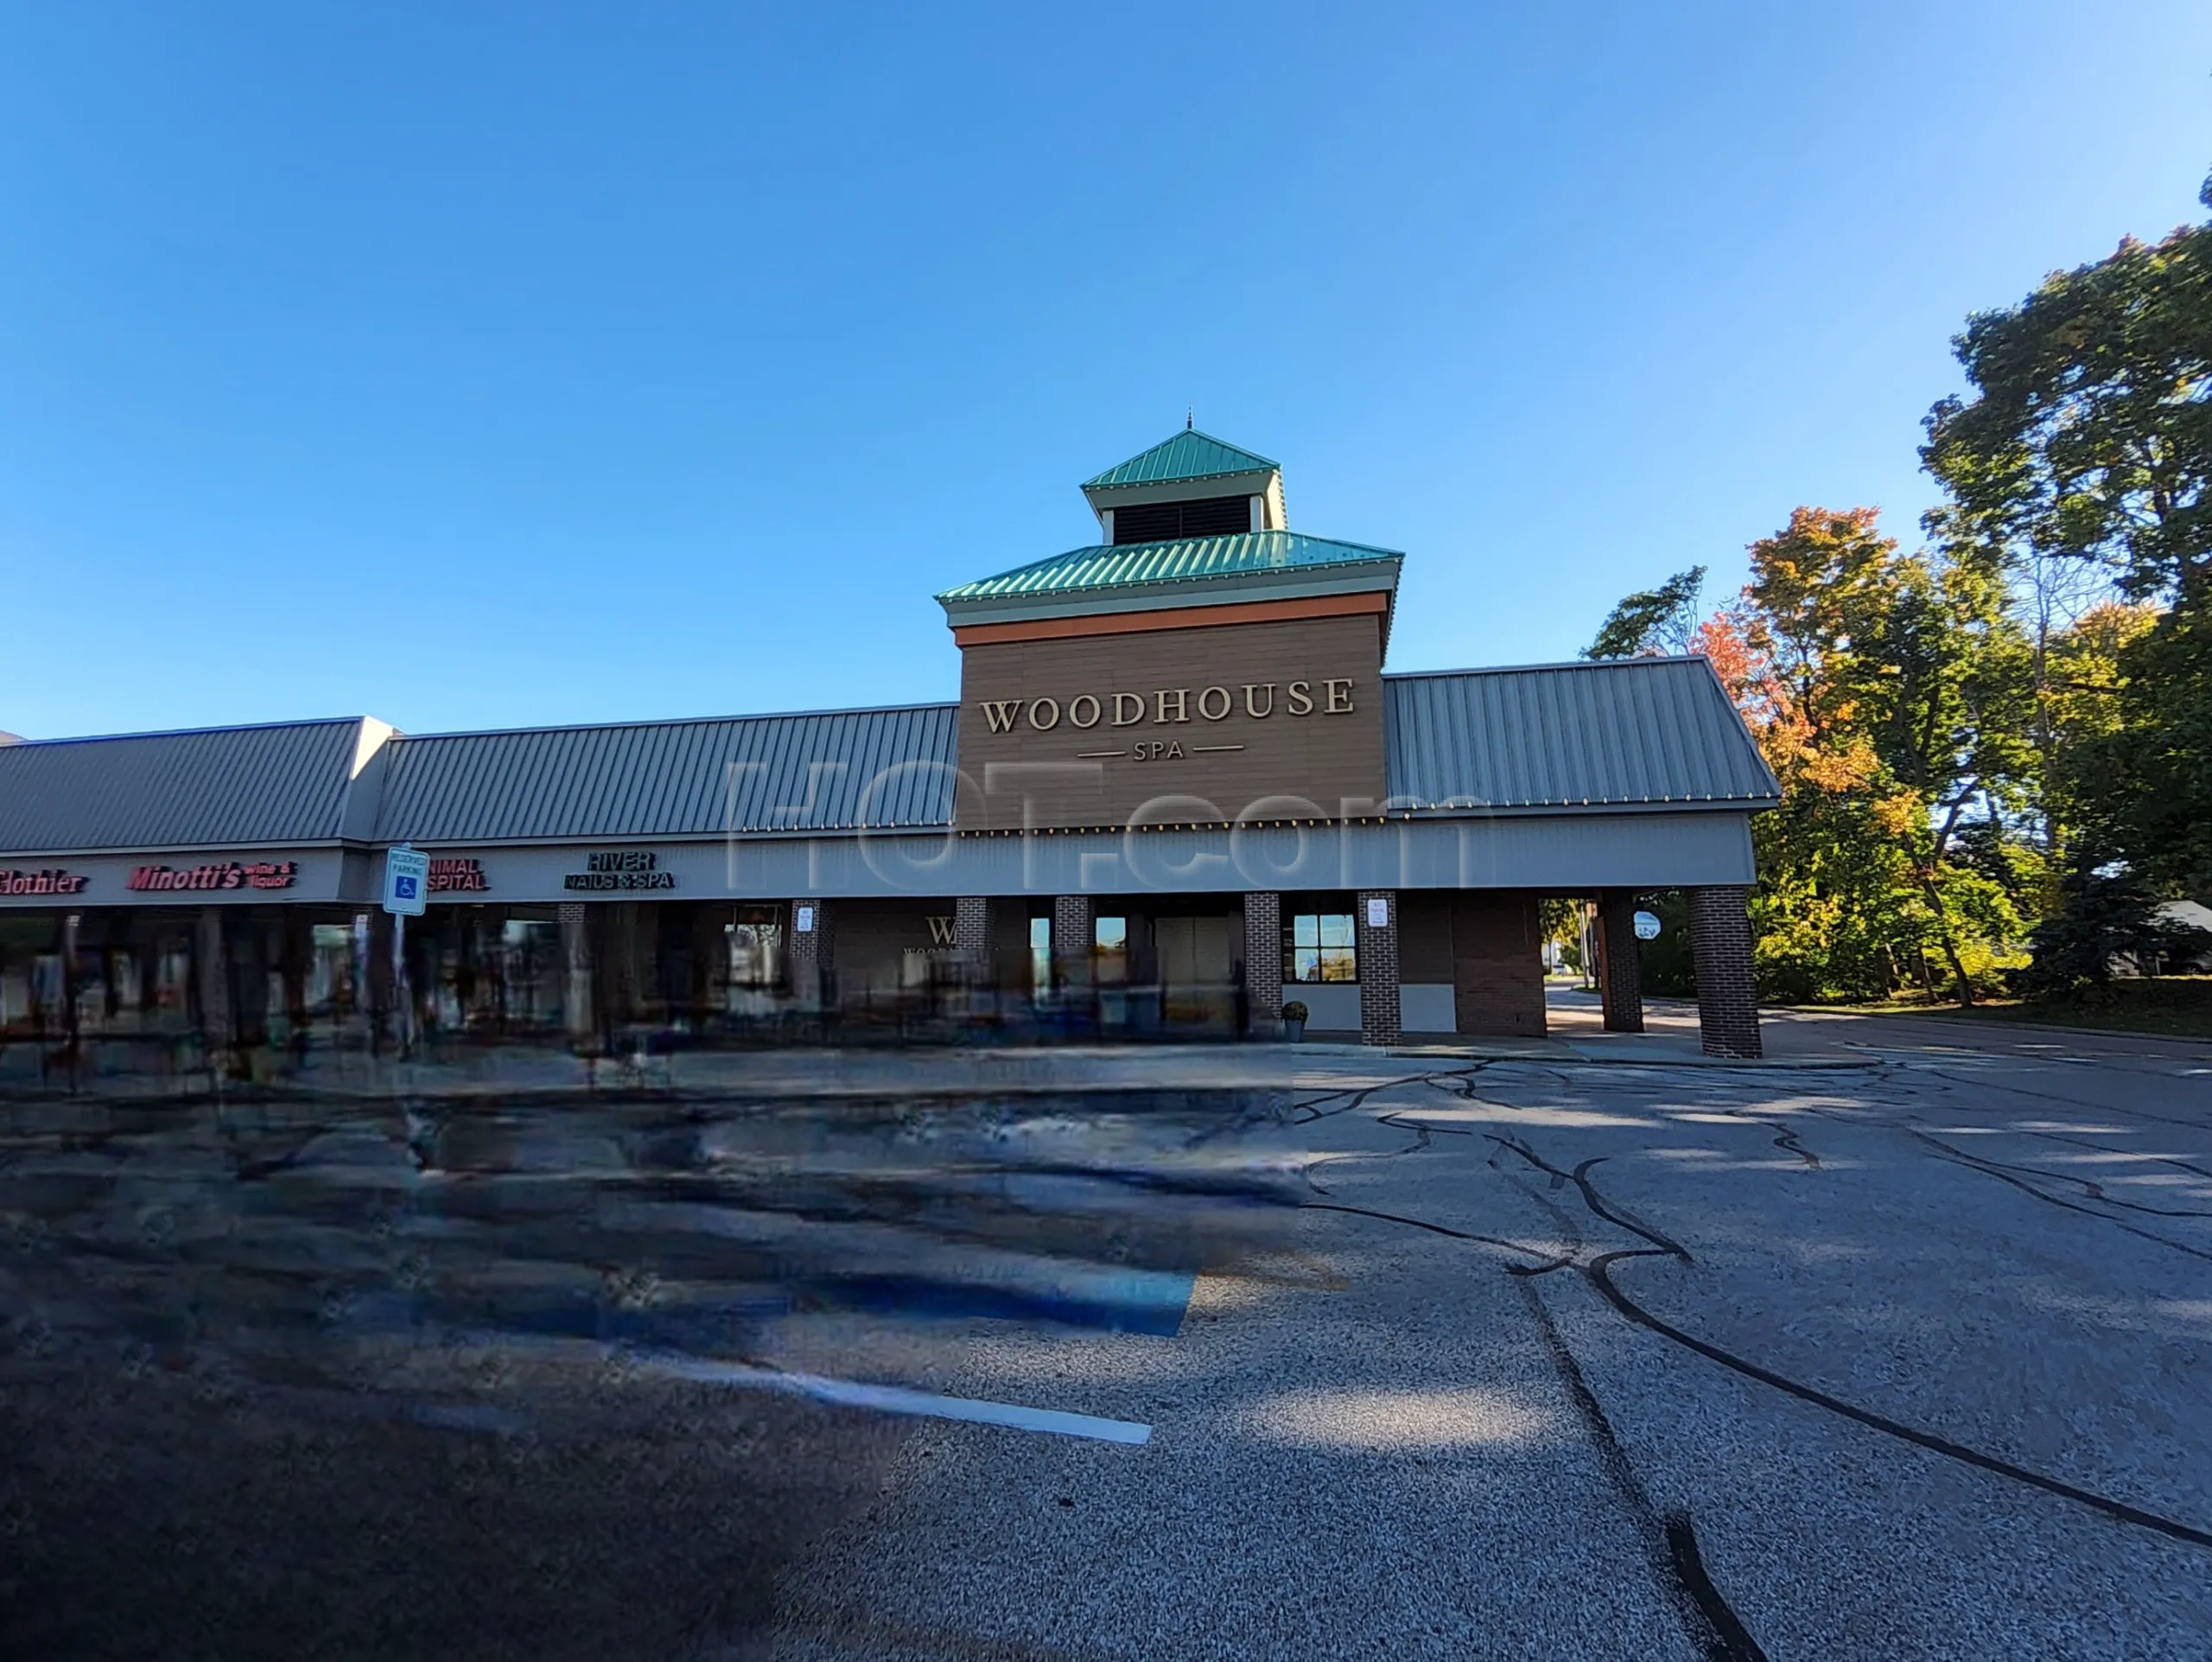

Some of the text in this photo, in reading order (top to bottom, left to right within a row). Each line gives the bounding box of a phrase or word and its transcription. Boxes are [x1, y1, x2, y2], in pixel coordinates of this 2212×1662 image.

[979, 678, 1355, 734] WOODHOUSE
[1133, 741, 1185, 761] SPA
[588, 851, 652, 871] RIVER
[124, 863, 242, 890] Minotti's
